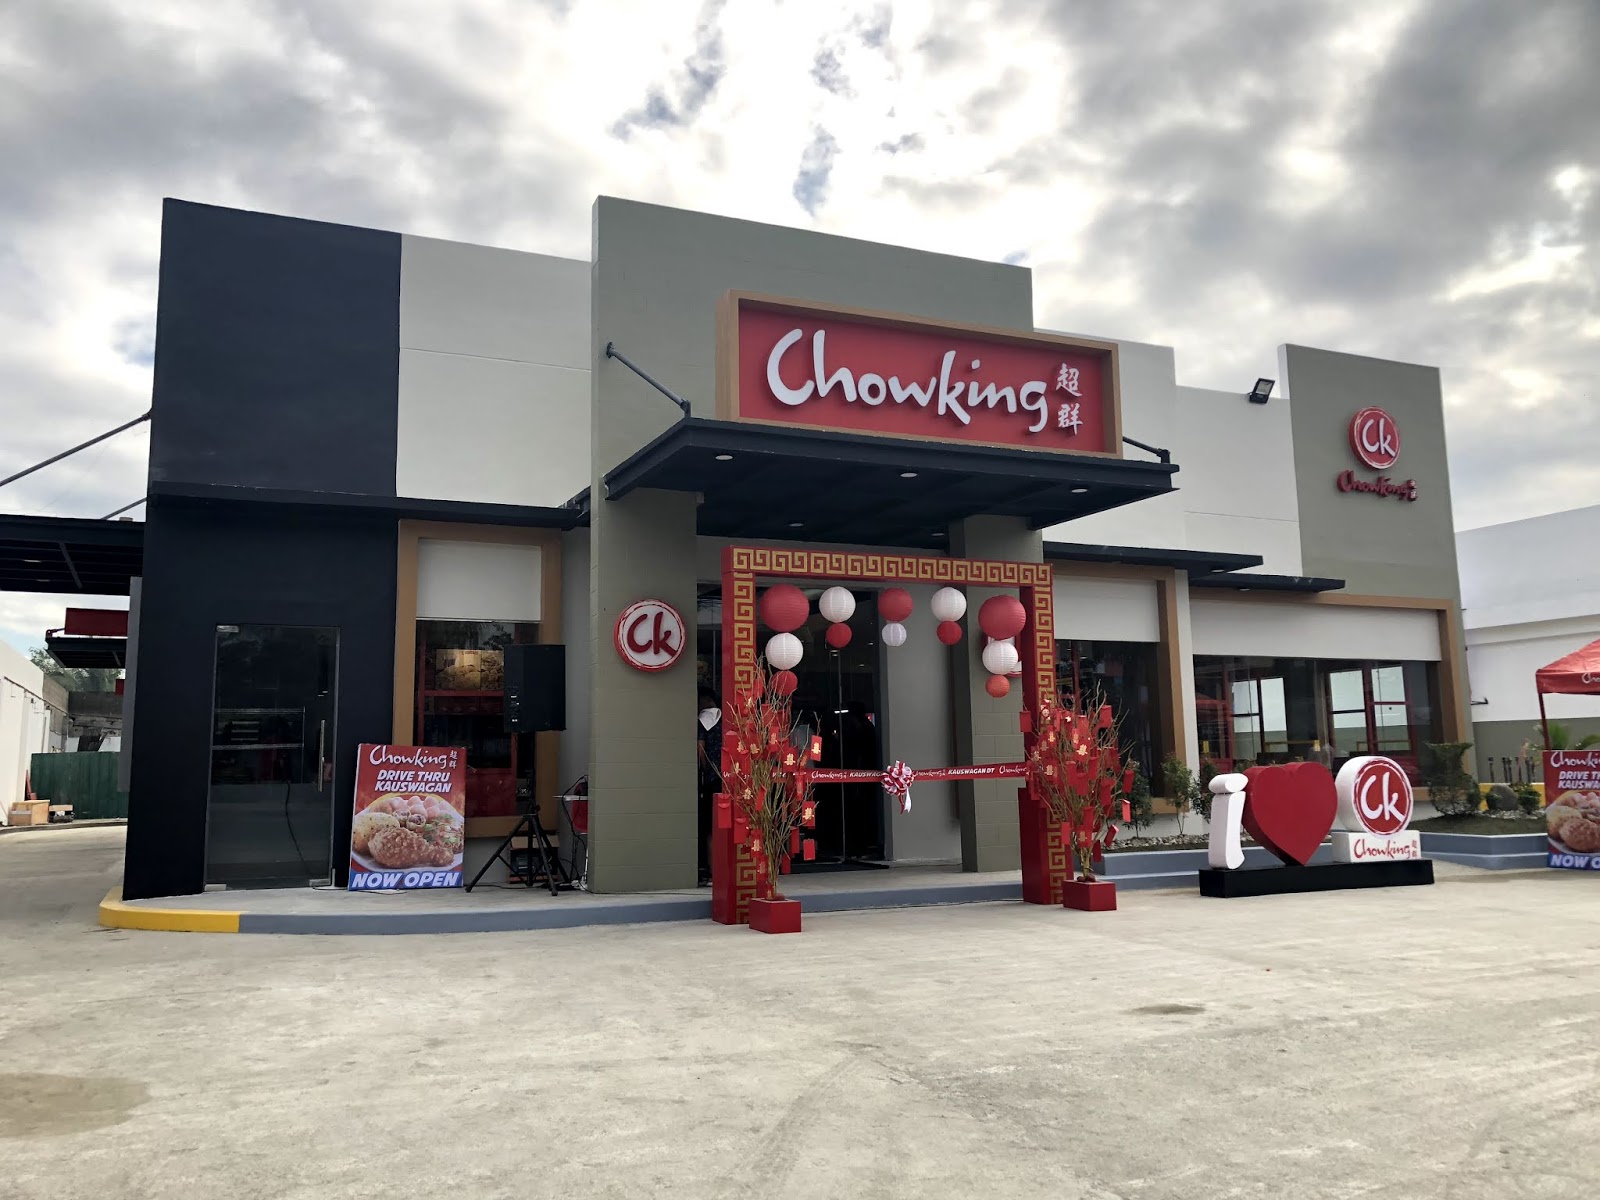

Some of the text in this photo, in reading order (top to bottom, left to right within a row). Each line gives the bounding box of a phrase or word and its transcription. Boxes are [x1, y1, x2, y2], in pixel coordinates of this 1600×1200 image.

[766, 328, 1049, 433] Chowking
[1362, 418, 1396, 457] Ck
[627, 611, 678, 657] Ck
[369, 745, 448, 769] Chowking
[1550, 751, 1600, 768] Chowki
[377, 770, 451, 782] DRIVE THRU
[1559, 771, 1589, 780] DRIVE
[374, 781, 452, 793] KAUSWAGAN
[1361, 771, 1406, 823] Ck
[1354, 839, 1410, 859] Chowking
[1551, 855, 1589, 867] NOW
[352, 872, 459, 888] NOW OPEN
